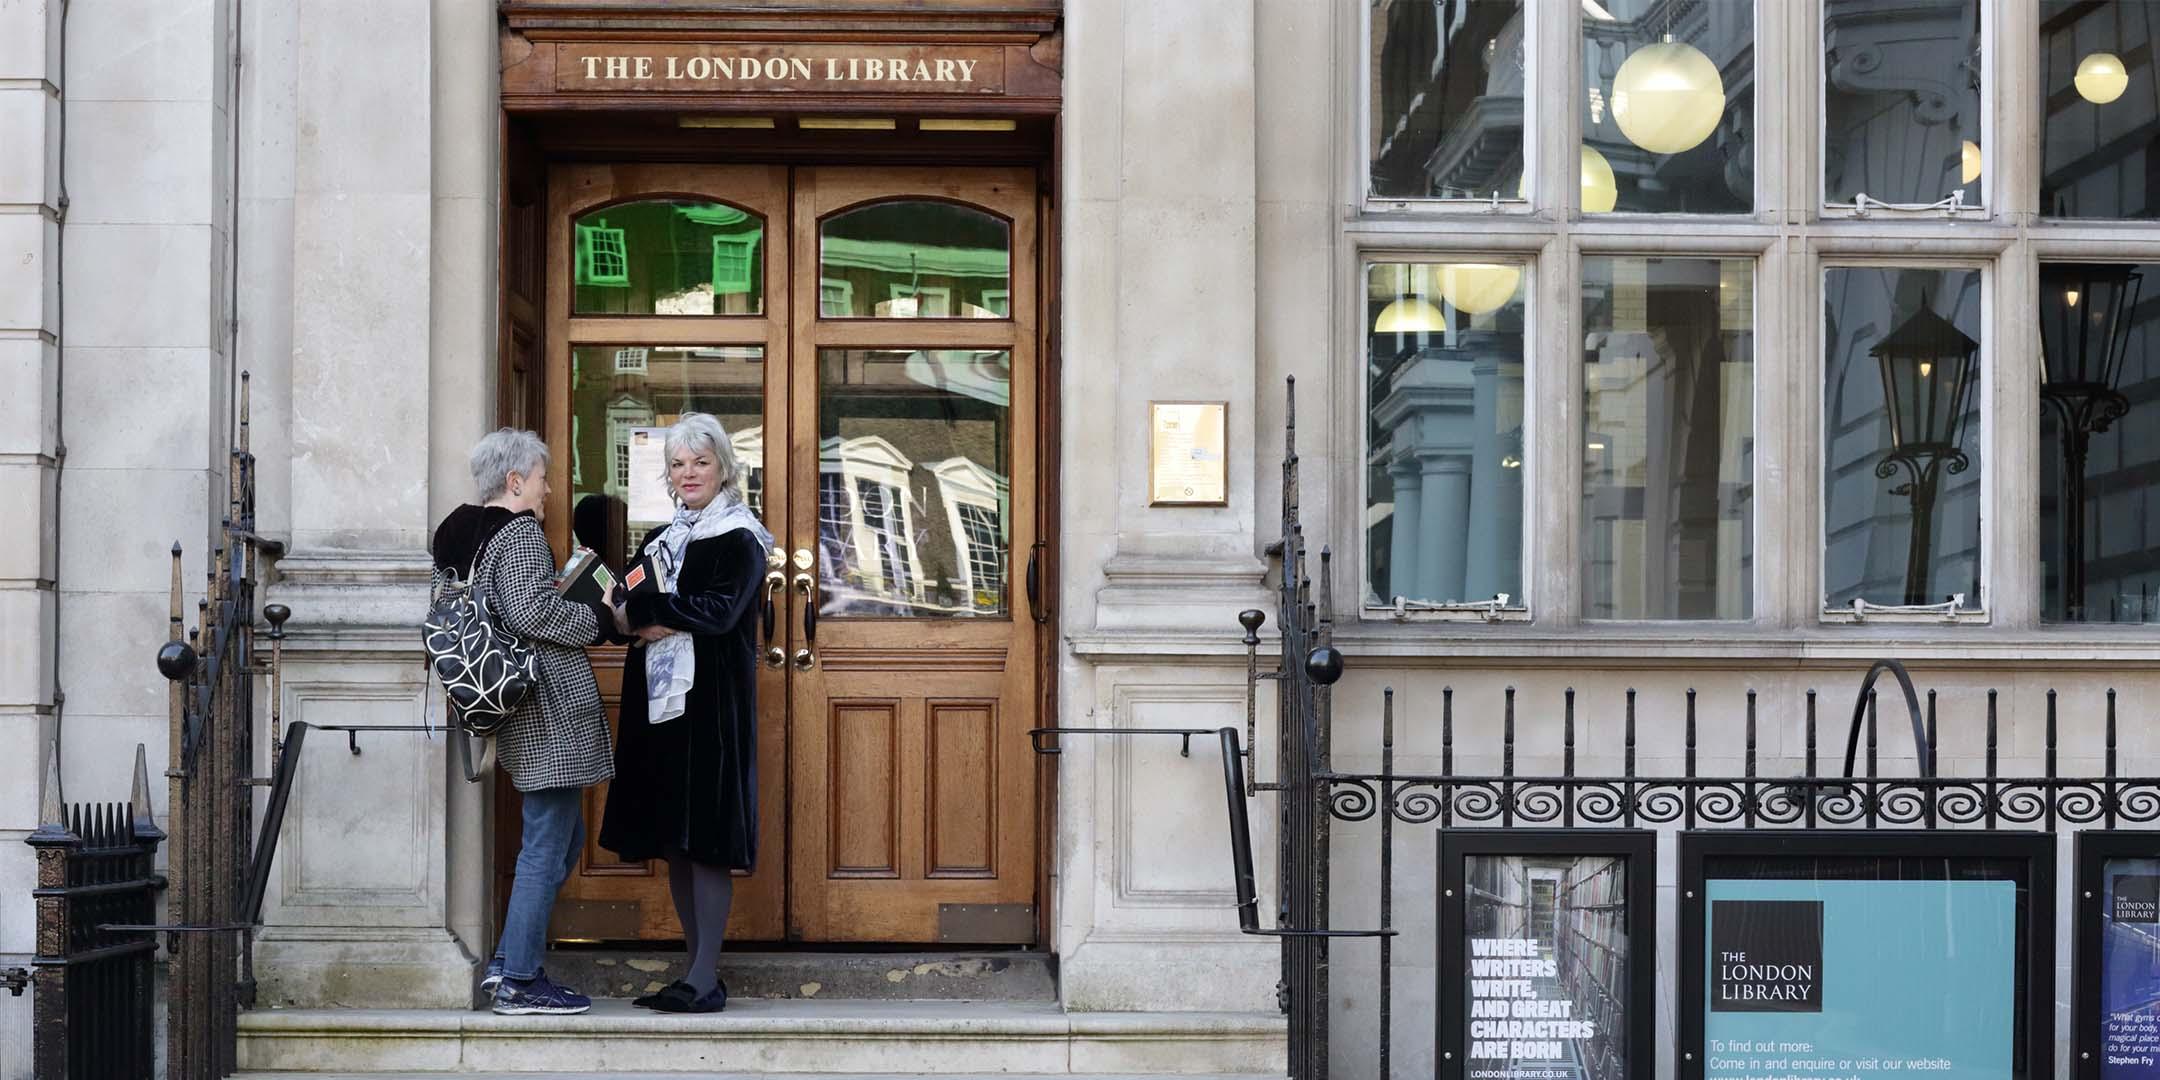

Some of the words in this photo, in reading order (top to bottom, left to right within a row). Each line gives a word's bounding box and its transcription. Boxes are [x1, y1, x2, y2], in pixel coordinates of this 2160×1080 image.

[581, 56, 653, 80] THE
[665, 56, 812, 81] LONDON
[825, 57, 977, 82] LIBRARY
[2116, 902, 2155, 910] LONDON
[2116, 910, 2154, 918] LIBRARY
[1471, 938, 1538, 957] WHERE
[1721, 951, 1746, 962] THE
[1471, 959, 1556, 977] WRITERS
[1722, 964, 1812, 981] LONDON
[1471, 979, 1537, 1000] WRITE,
[1722, 983, 1812, 1000] LIBRARY
[1471, 1000, 1509, 1018] AND
[1511, 1000, 1572, 1018] GREAT
[1470, 1020, 1594, 1039] CHARACTERS
[2109, 1024, 2119, 1032] for
[2120, 1025, 2138, 1033] your
[2138, 1024, 2158, 1033] body,
[1710, 1039, 1725, 1053] To
[1728, 1039, 1752, 1053] find
[1755, 1040, 1775, 1053] out
[1779, 1041, 1814, 1053] more:
[2108, 1033, 2138, 1044] magical
[2138, 1034, 2160, 1044] place
[1470, 1041, 1508, 1059] ARE
[1510, 1041, 1563, 1059] BORN
[2108, 1044, 2119, 1053] do
[2119, 1044, 2131, 1053] for
[2132, 1045, 2149, 1055] your
[1710, 1056, 1745, 1070] Come
[1750, 1057, 1761, 1070] in
[1765, 1056, 1788, 1070] and
[1791, 1057, 1836, 1073] enquire
[1839, 1060, 1852, 1070] or
[1855, 1057, 1879, 1070] visit
[1882, 1060, 1903, 1070] our
[1906, 1057, 1952, 1070] website
[2108, 1055, 2140, 1066] Stephen
[2141, 1056, 2154, 1067] Fry
[1470, 1069, 1570, 1079] LONDONLIBRARY.CO.UK
